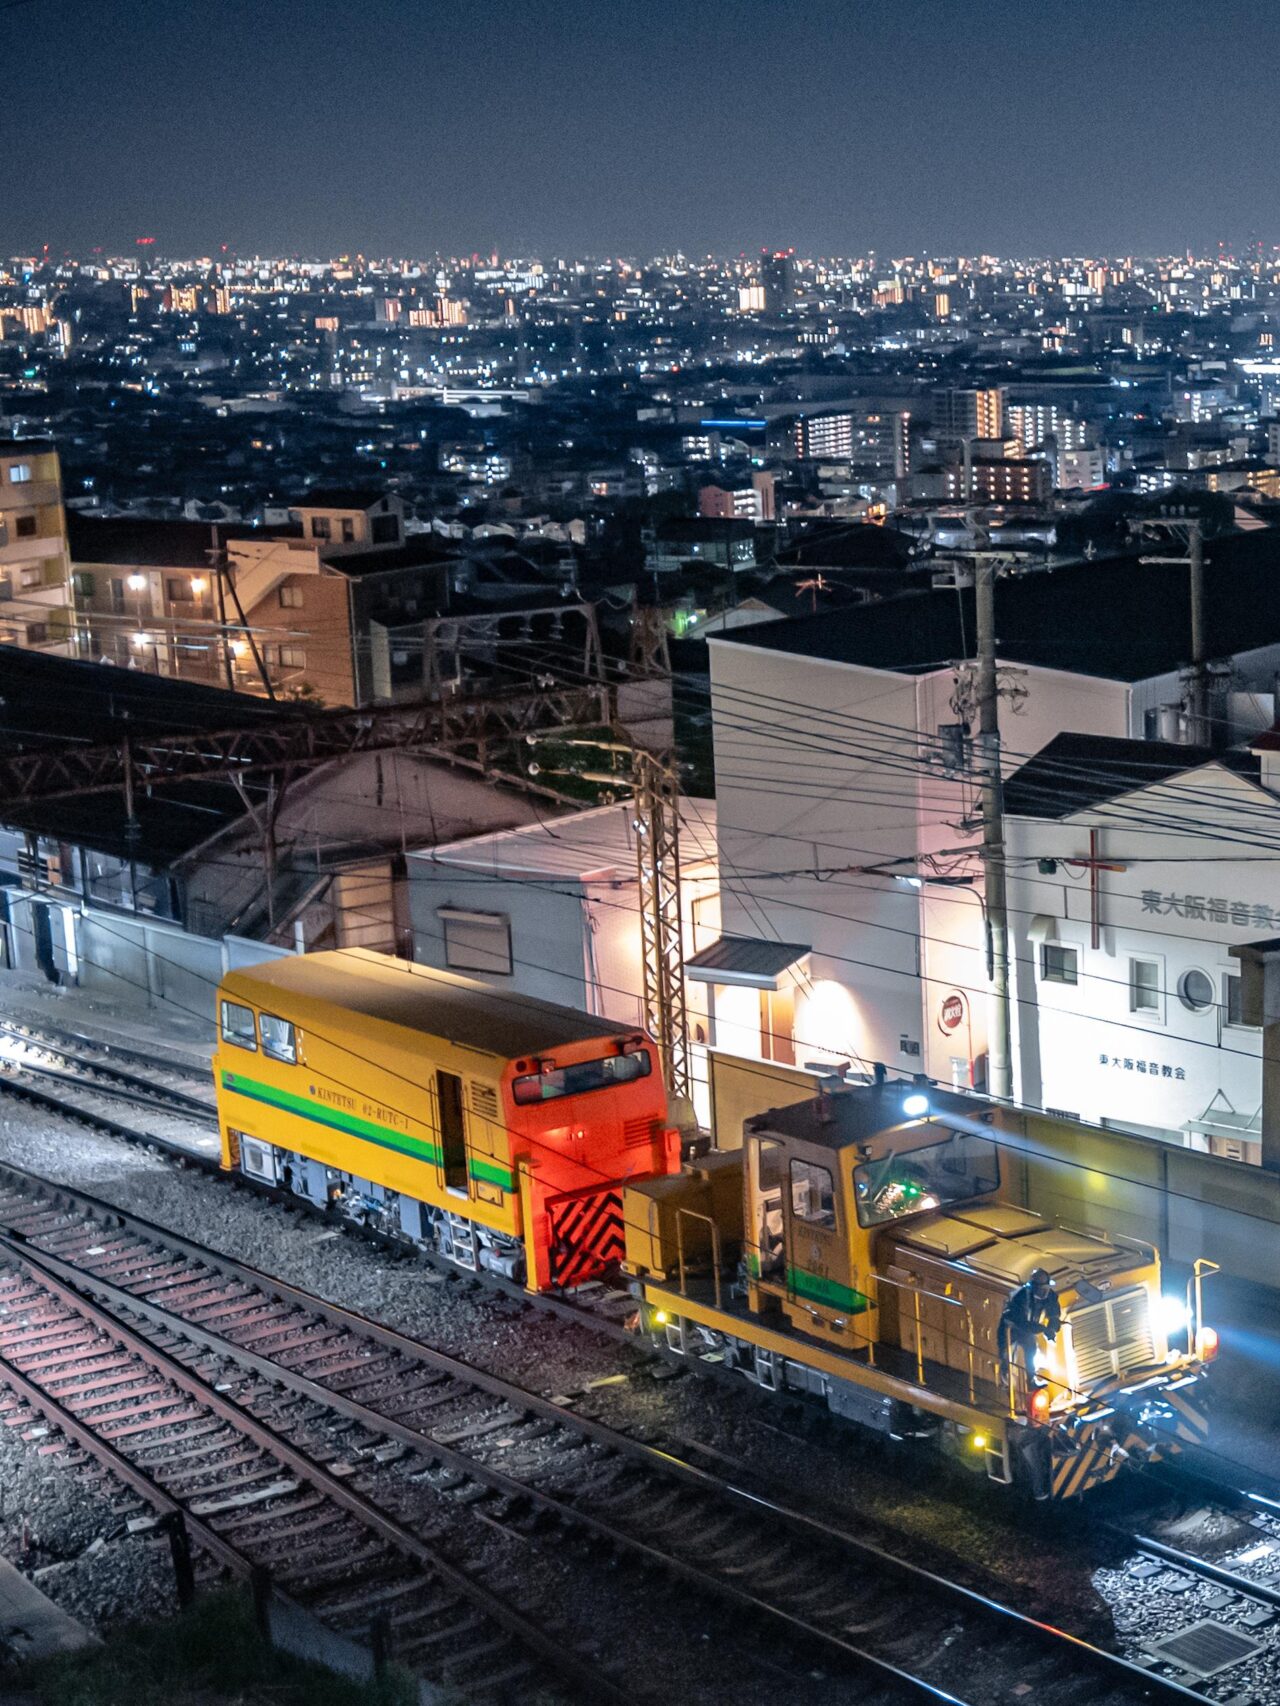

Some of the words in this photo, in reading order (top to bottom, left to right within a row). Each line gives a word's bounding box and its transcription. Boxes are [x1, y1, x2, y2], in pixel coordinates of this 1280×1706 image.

[1099, 1054, 1186, 1080] 東大阪福音教会
[317, 1087, 356, 1110] KINTETSU
